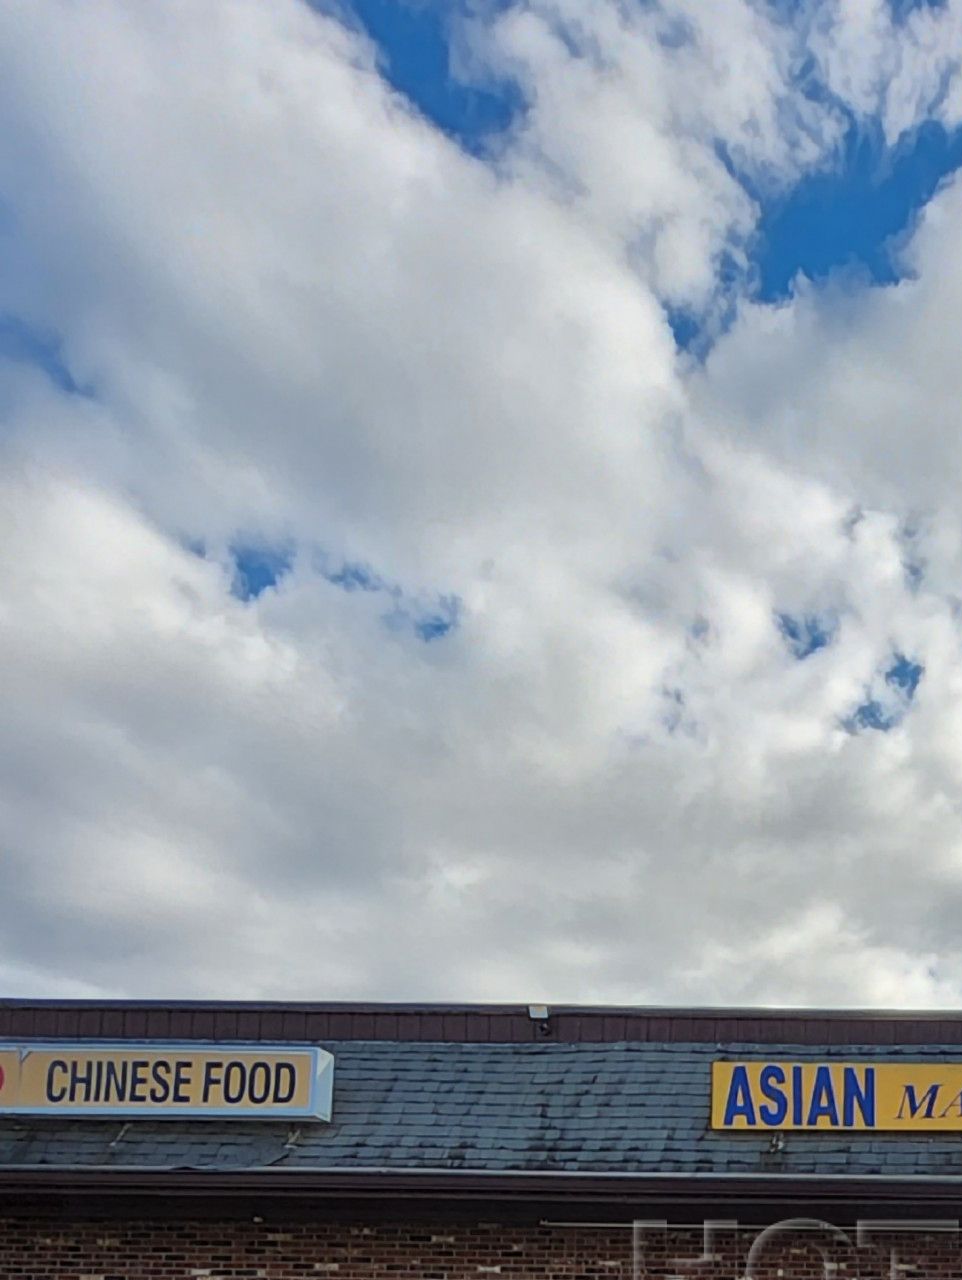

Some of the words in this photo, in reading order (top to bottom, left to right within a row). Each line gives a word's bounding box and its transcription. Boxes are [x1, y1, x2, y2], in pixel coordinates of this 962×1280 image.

[46, 1060, 192, 1103] CHINESE
[202, 1062, 296, 1104] FOOD
[723, 1065, 875, 1127] ASIAN
